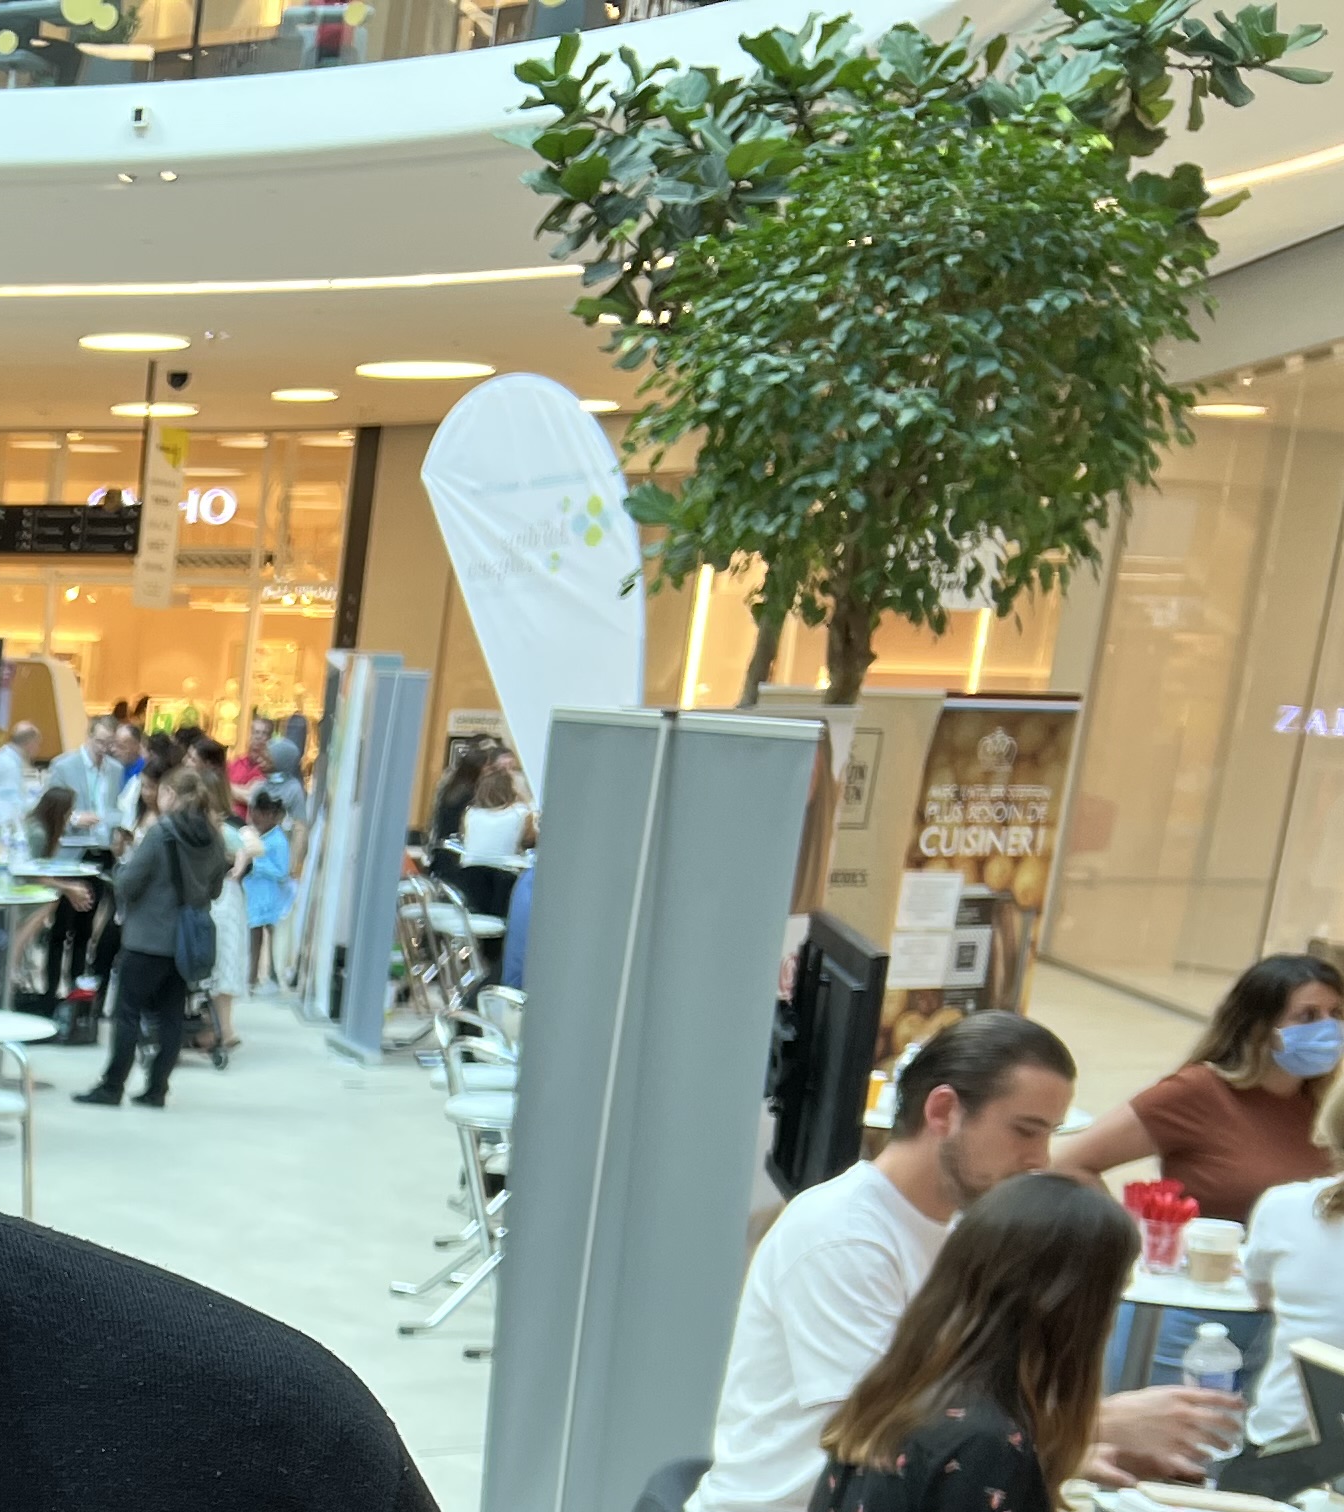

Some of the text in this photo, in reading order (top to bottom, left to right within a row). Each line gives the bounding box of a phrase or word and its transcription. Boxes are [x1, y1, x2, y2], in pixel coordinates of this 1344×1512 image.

[925, 800, 1050, 823] PLUS BESOIN DE
